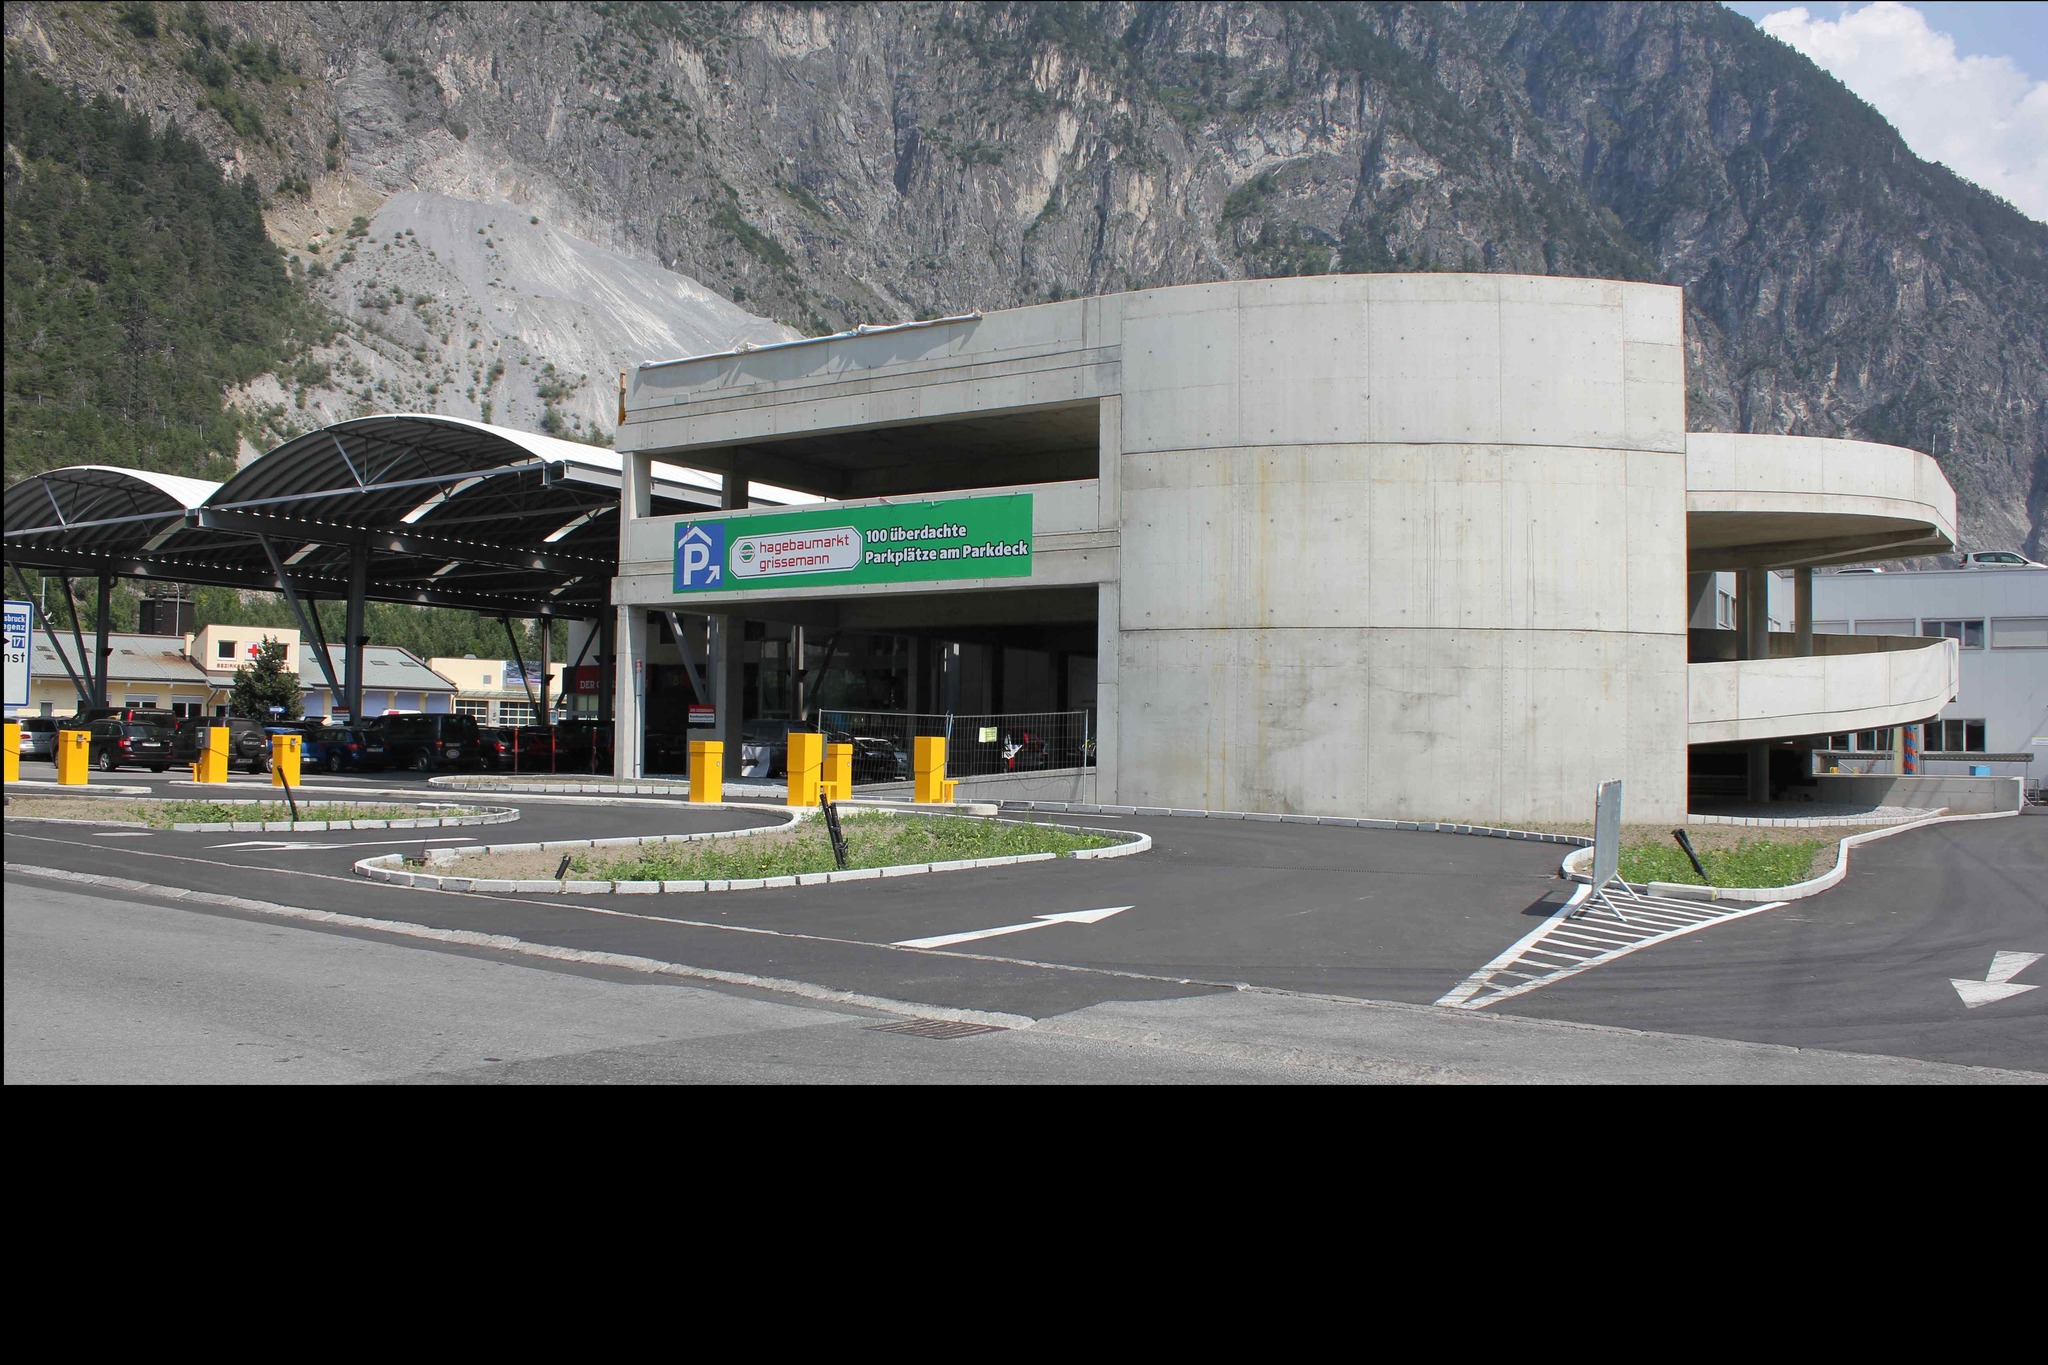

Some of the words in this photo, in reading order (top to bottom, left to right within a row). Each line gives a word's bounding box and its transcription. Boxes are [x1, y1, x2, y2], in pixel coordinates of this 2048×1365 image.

[865, 529, 888, 543] 100
[889, 523, 967, 541] überdachte
[759, 534, 850, 555] hagebaumarkt
[865, 547, 937, 566] Parkplätze
[939, 548, 960, 560] am
[962, 540, 1029, 558] Parkdeck
[683, 543, 710, 586] P
[759, 556, 830, 573] grissemann
[12, 636, 25, 648] 171
[580, 681, 595, 689] DER
